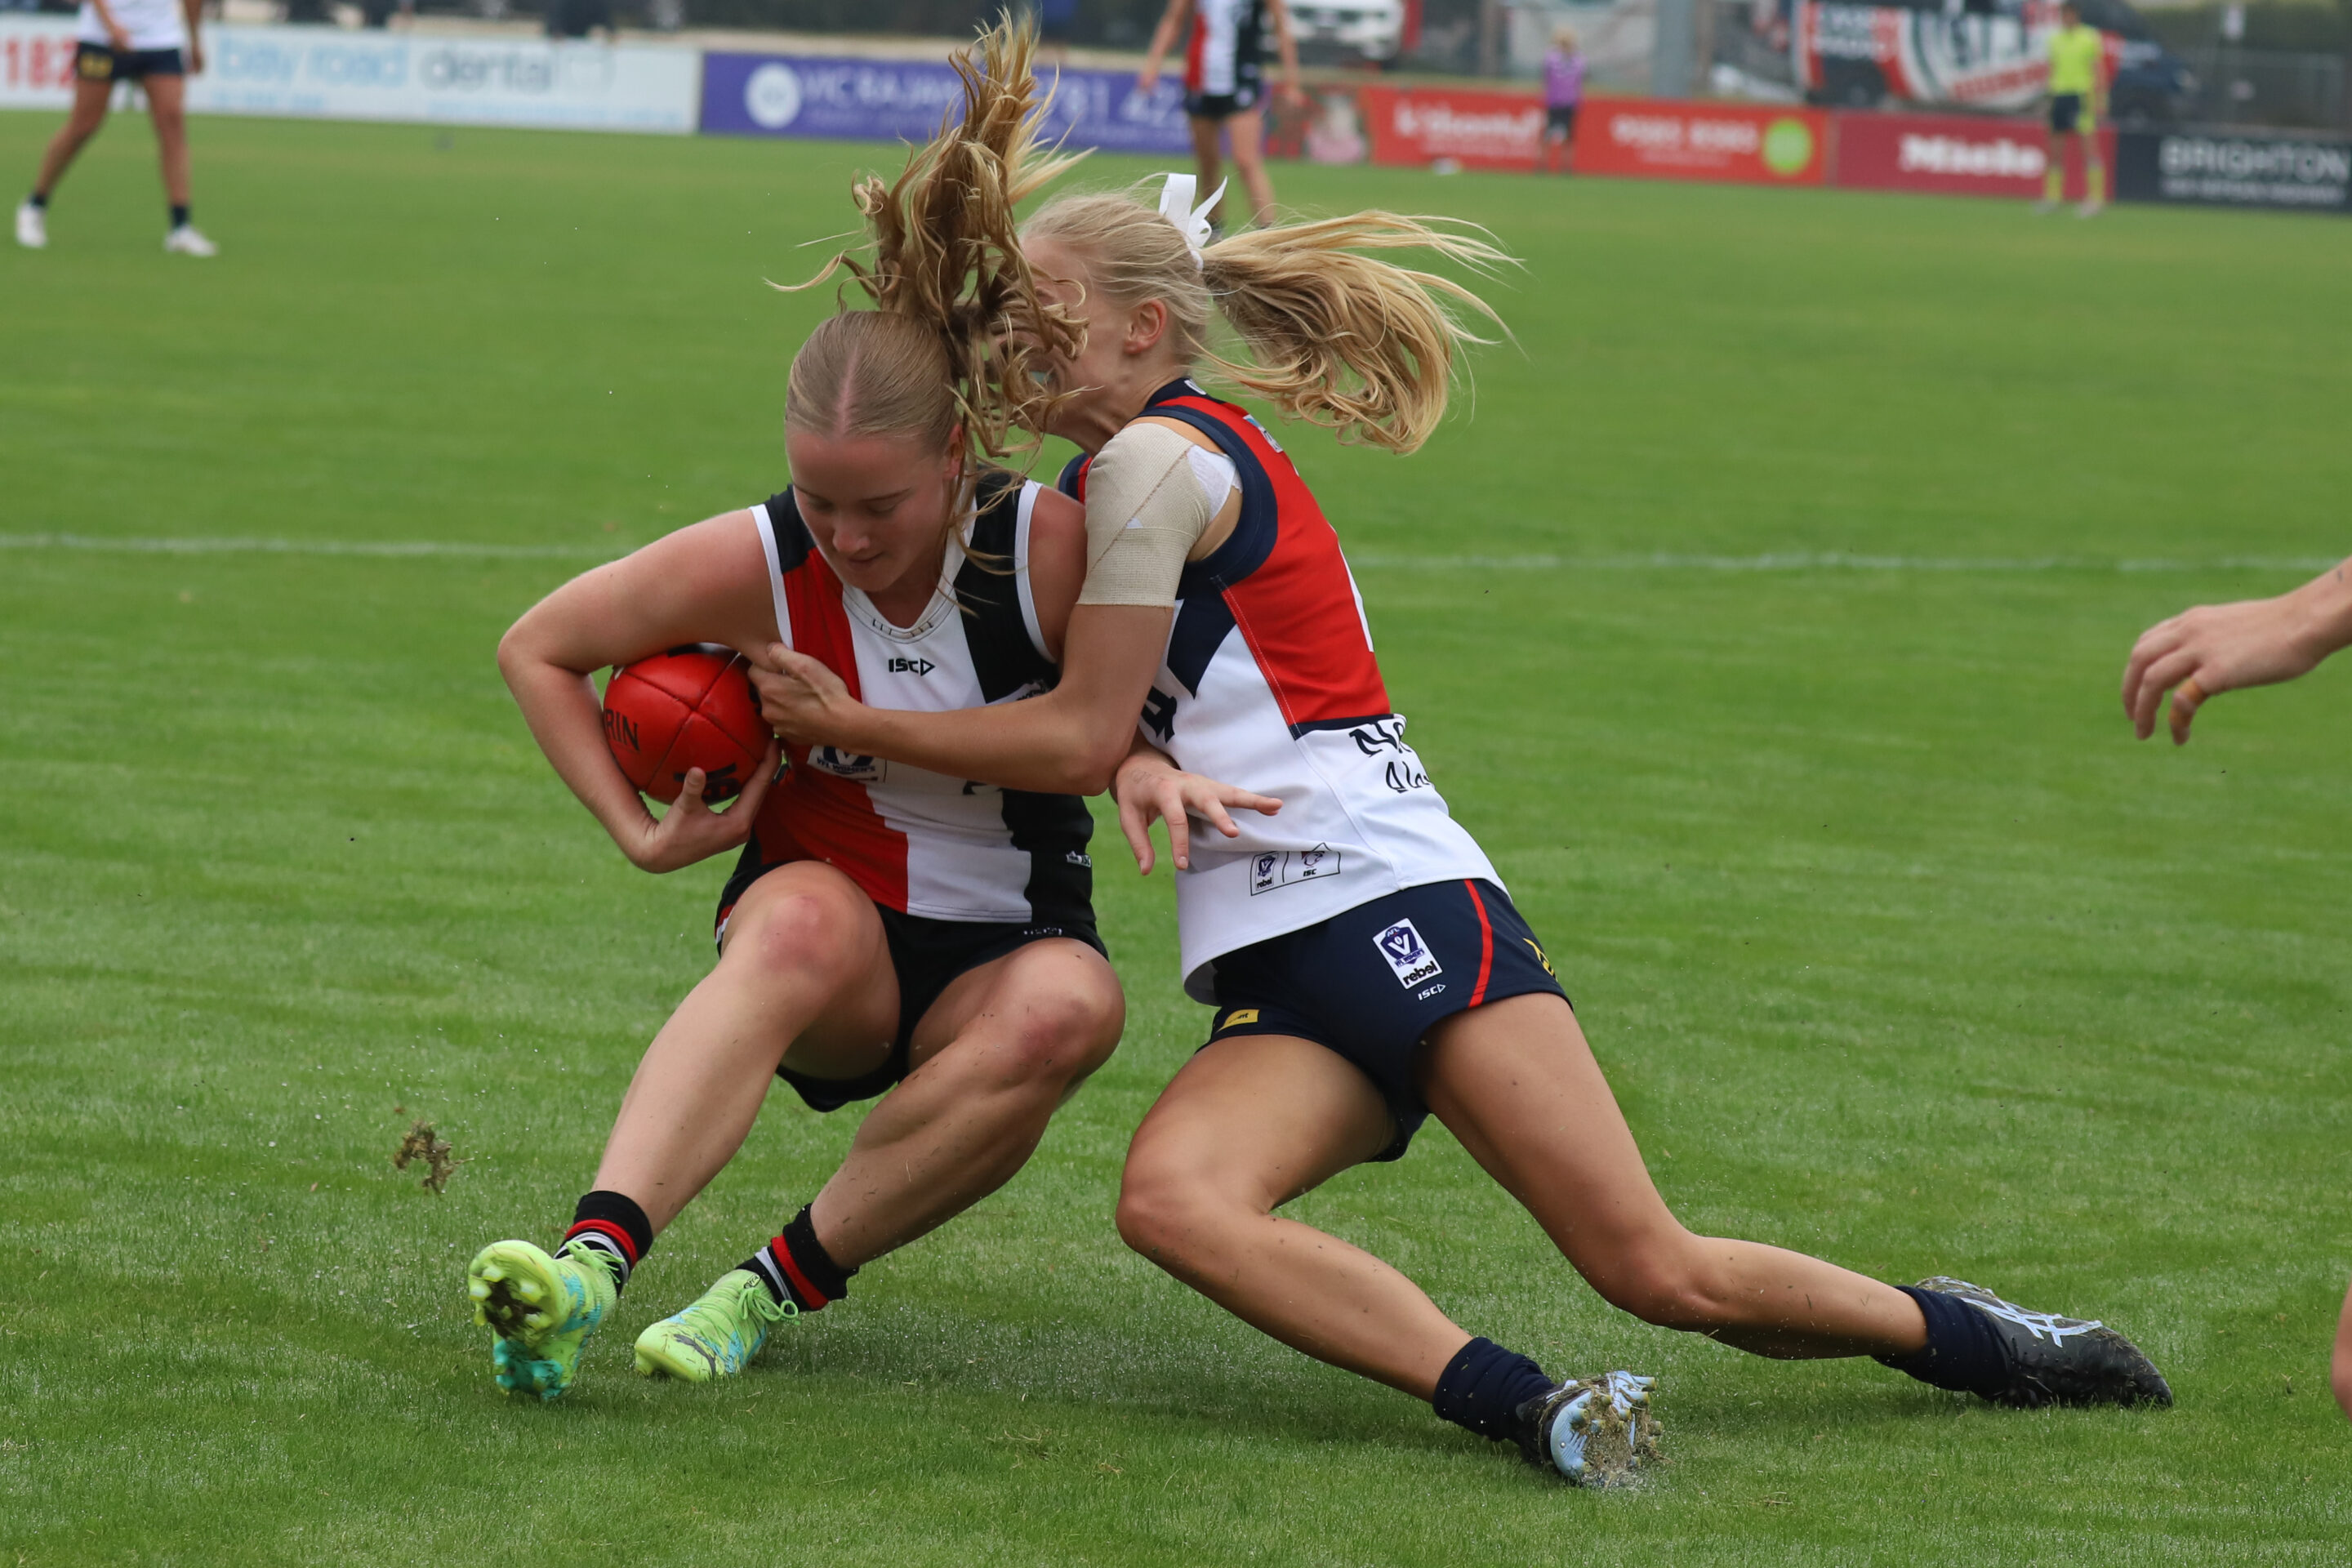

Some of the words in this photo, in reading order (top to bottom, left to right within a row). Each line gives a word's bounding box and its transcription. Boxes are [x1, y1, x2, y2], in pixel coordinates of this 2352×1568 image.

[420, 47, 553, 93] dental
[2160, 136, 2350, 185] BRIGHTON
[1257, 877, 1272, 889] rebel
[1387, 927, 1401, 938] AFL
[1402, 960, 1438, 986] rebel
